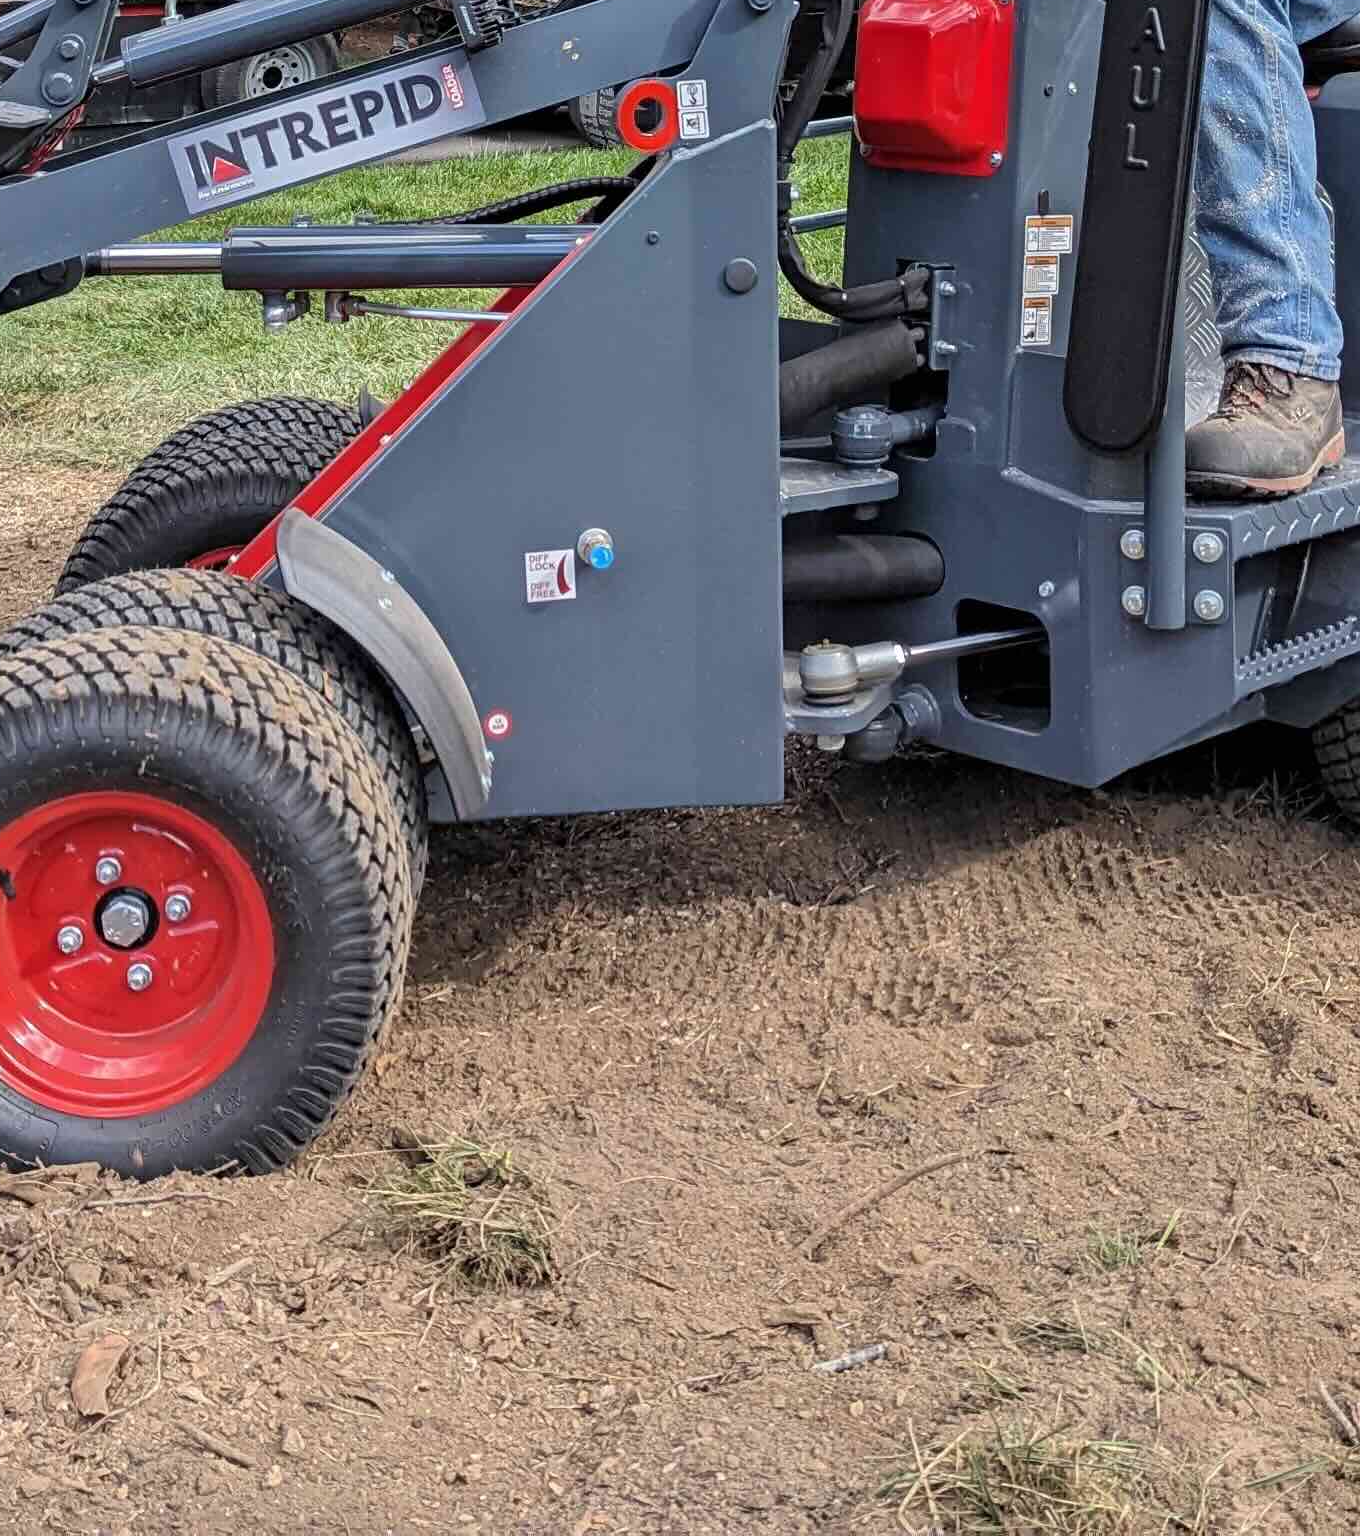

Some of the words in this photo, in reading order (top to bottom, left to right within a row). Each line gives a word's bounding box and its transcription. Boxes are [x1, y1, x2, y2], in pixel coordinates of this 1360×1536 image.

[442, 64, 464, 109] LOADER
[184, 74, 442, 189] INTREPID
[529, 554, 549, 563] DIFF
[529, 562, 557, 572] LOCK
[530, 582, 551, 592] DIFF
[531, 590, 556, 599] FREE
